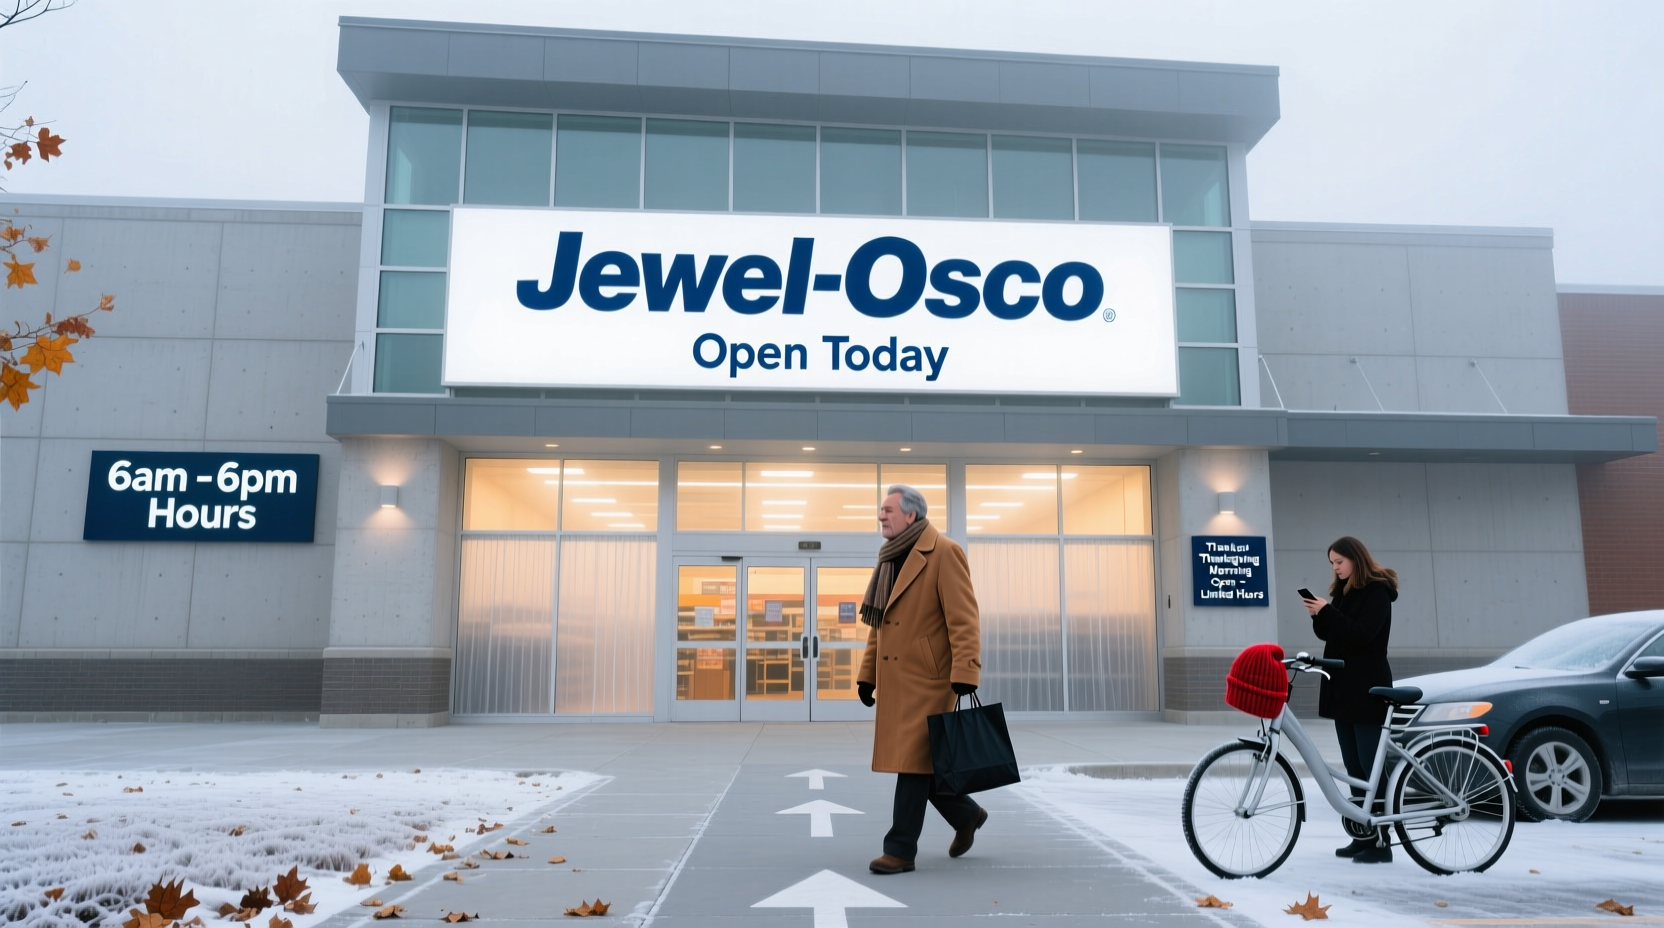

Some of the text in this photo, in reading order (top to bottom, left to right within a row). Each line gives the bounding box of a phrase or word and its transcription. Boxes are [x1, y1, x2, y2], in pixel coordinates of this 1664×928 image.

[516, 231, 1105, 322] Jewel-Osco
[692, 332, 950, 382] Open Today
[107, 459, 188, 492] 6am
[147, 497, 257, 530] Hours
